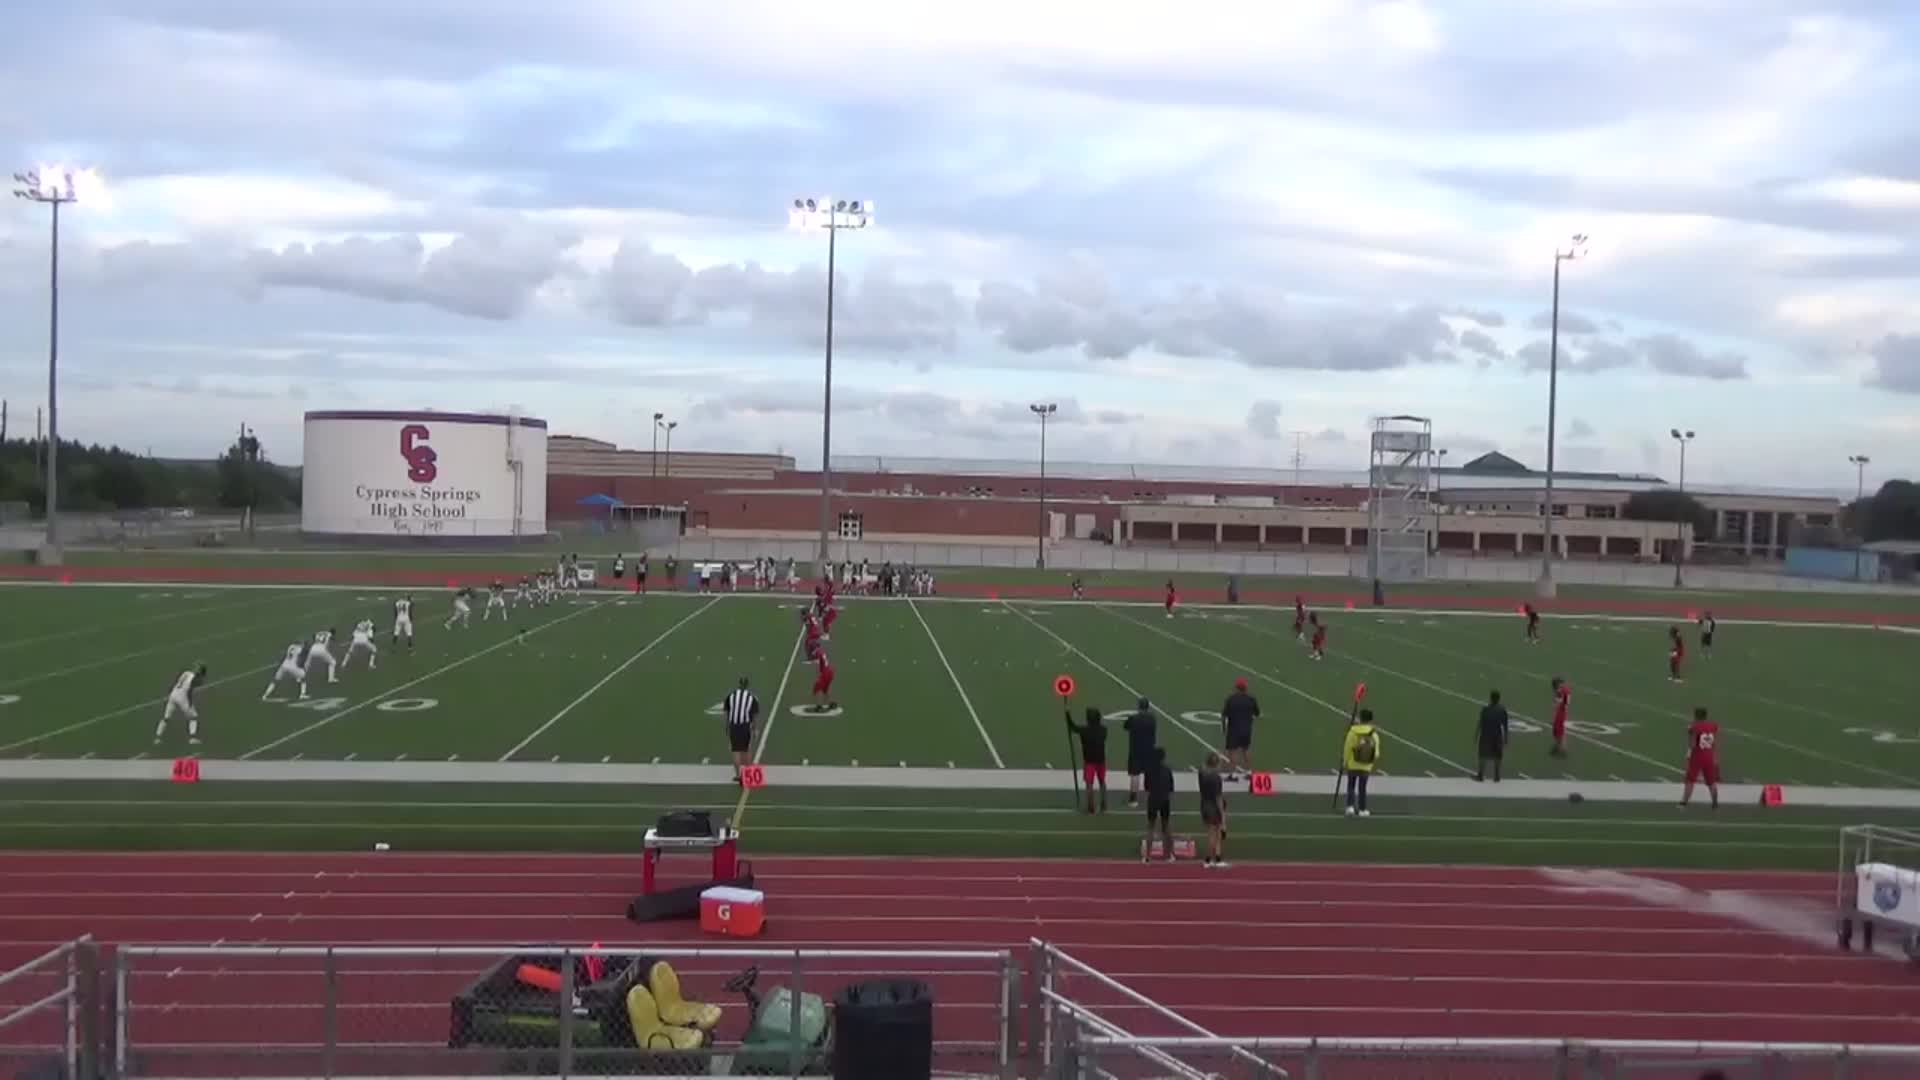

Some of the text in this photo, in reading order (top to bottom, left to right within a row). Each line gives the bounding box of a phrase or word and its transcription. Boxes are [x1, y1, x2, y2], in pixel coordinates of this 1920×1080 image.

[356, 485, 481, 503] Cypress Springs
[371, 503, 465, 518] High School
[172, 761, 195, 778] 40
[744, 769, 763, 785] 50
[1255, 775, 1272, 790] 40
[718, 904, 731, 920] G
